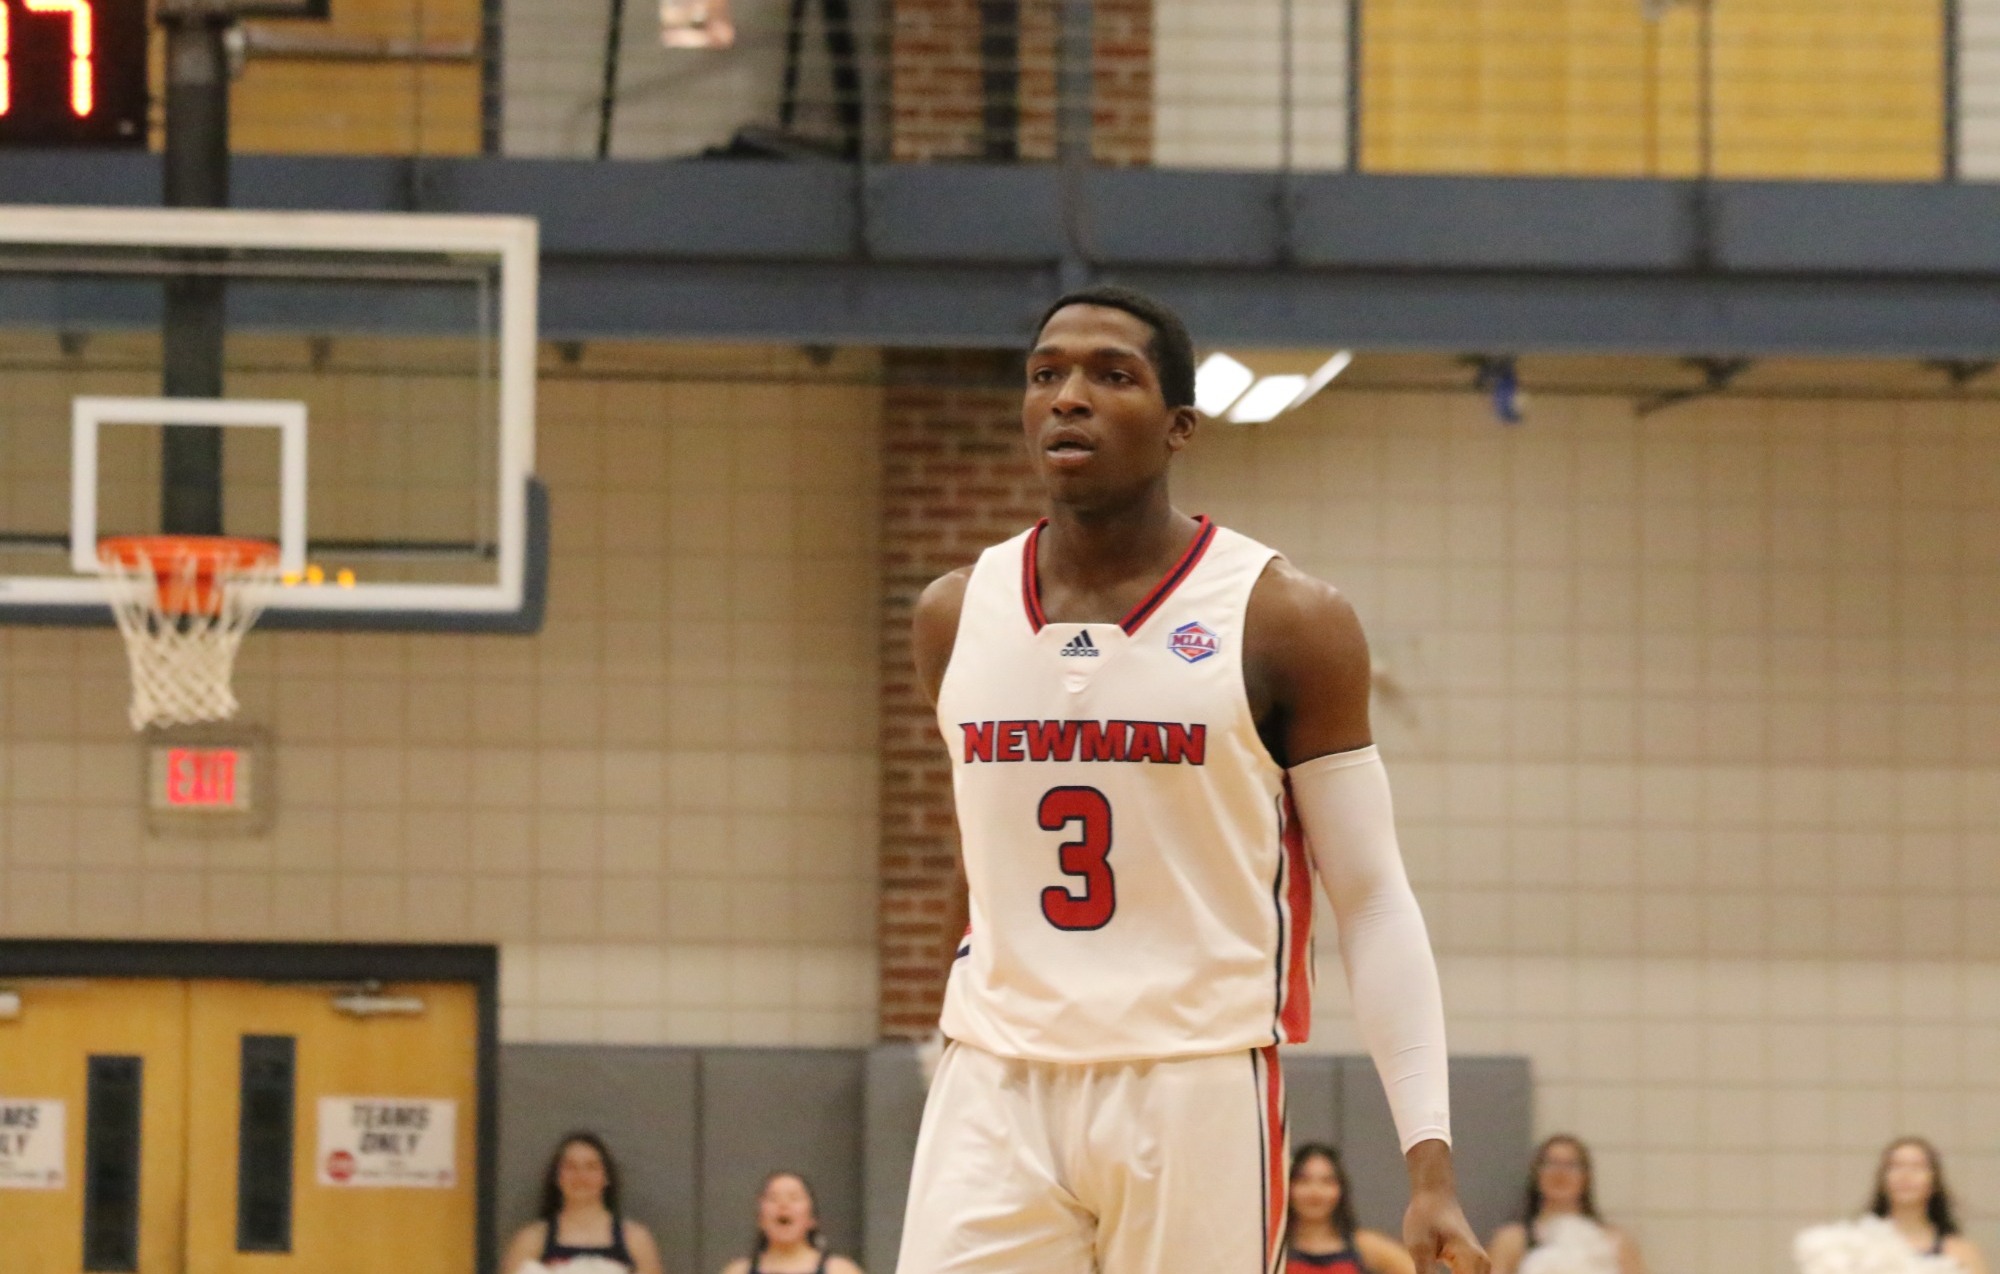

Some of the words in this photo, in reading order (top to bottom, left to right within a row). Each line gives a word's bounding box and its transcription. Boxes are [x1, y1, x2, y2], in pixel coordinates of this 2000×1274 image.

[1060, 646, 1099, 657] adidas
[1172, 634, 1216, 650] MIAA
[959, 720, 1207, 765] NEWMAN
[167, 747, 237, 805] EXIT
[1038, 785, 1116, 931] 3
[351, 1104, 430, 1131] TEAMS
[359, 1131, 421, 1155] ONLY
